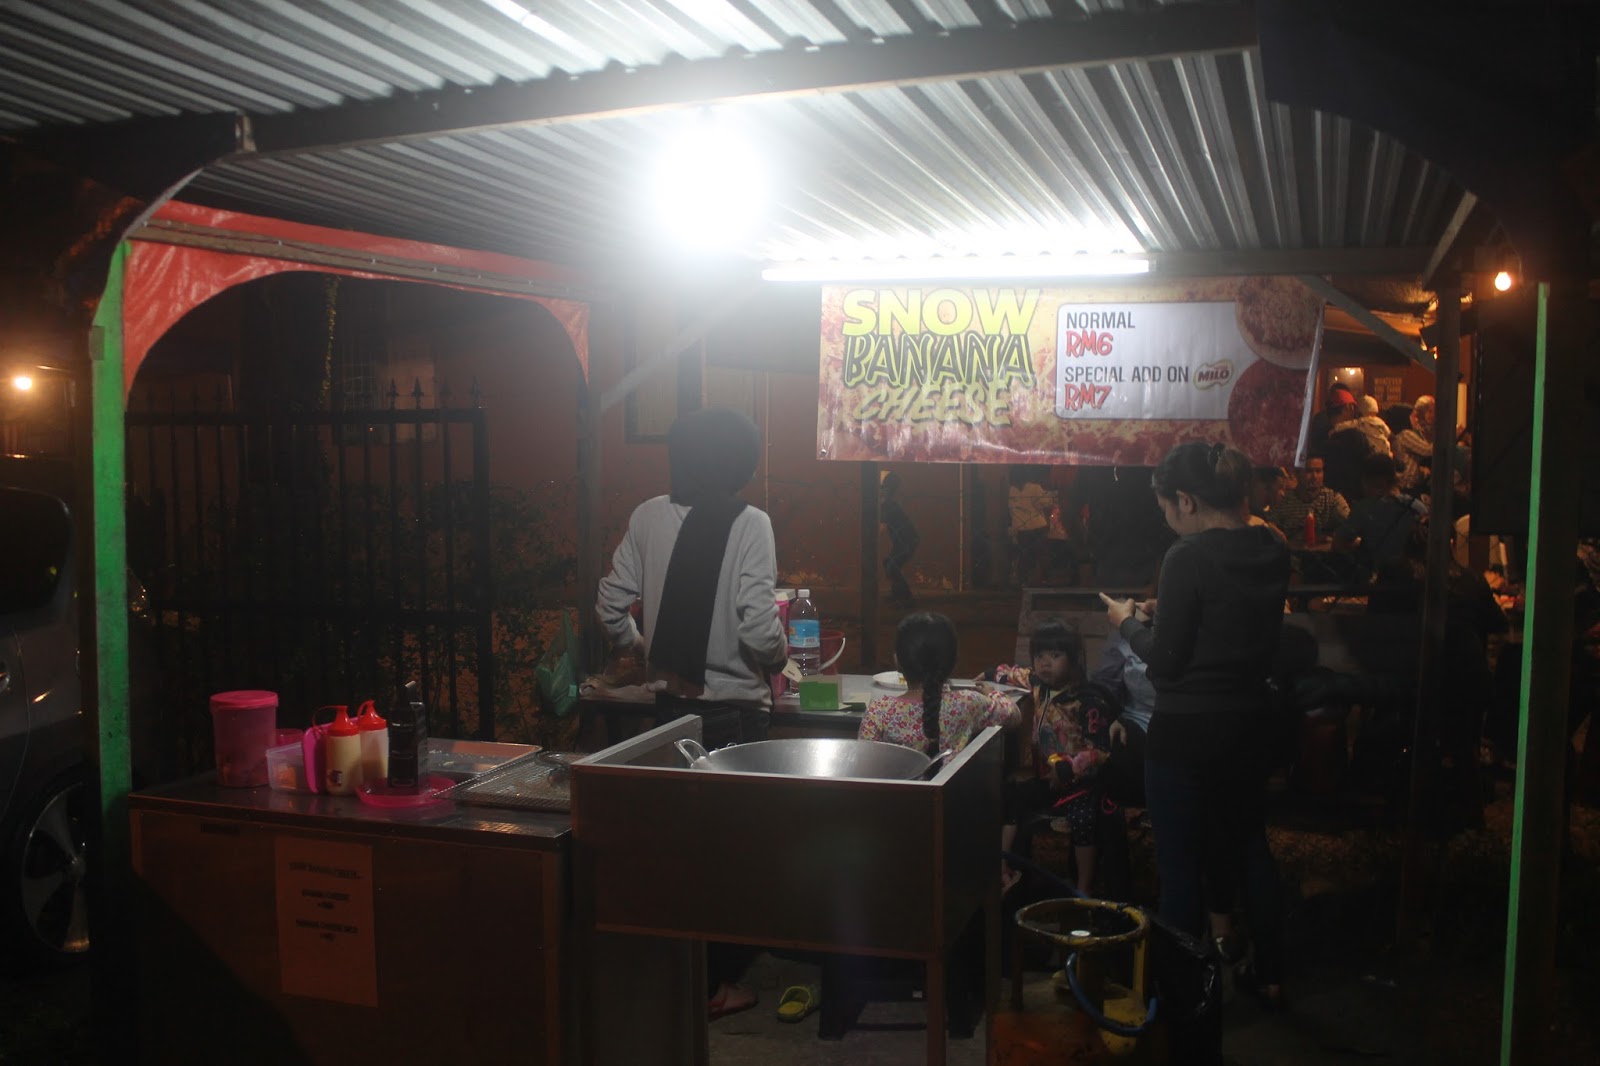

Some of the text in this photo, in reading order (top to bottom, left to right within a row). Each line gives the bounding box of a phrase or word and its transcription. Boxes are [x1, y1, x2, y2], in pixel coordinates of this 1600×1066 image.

[842, 288, 1041, 336] SNOW
[1066, 312, 1136, 329] NORMAL
[1065, 329, 1114, 358] RM6
[843, 330, 1036, 389] BANANA
[1064, 366, 1189, 383] SPECIAL ADD ON
[1197, 369, 1231, 383] MILO
[852, 378, 1011, 428] CHEESE
[1064, 382, 1113, 412] RM7
